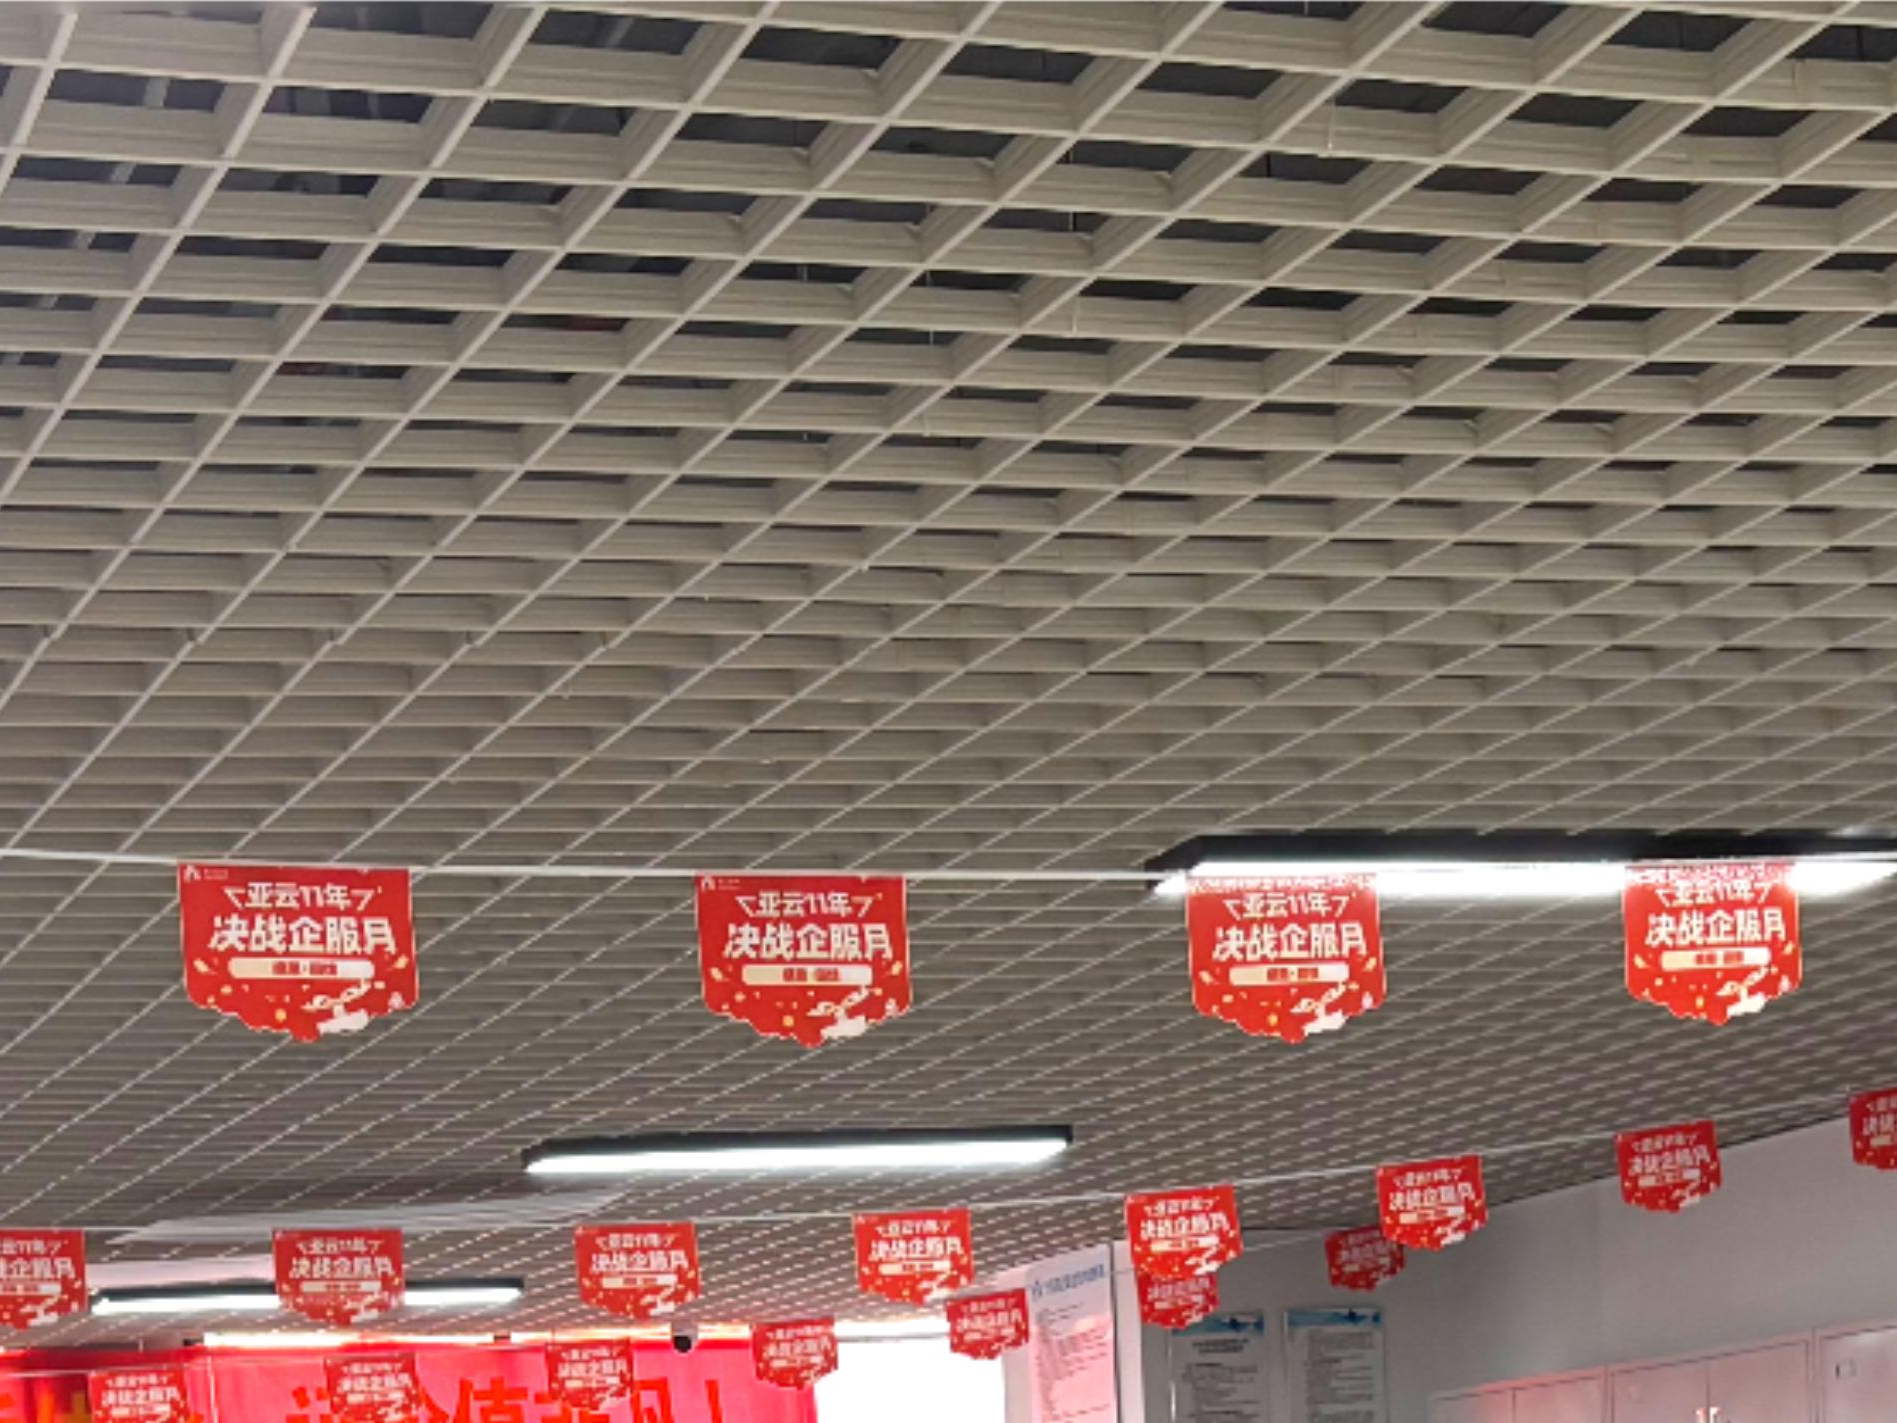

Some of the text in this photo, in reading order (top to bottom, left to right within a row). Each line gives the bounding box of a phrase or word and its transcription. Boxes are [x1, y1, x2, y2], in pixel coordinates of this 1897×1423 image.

[207, 913, 396, 955] 决战企服月
[723, 923, 892, 960] 决战企服月
[1212, 922, 1367, 961] 决战企服月
[1645, 907, 1786, 947] 决战企服月
